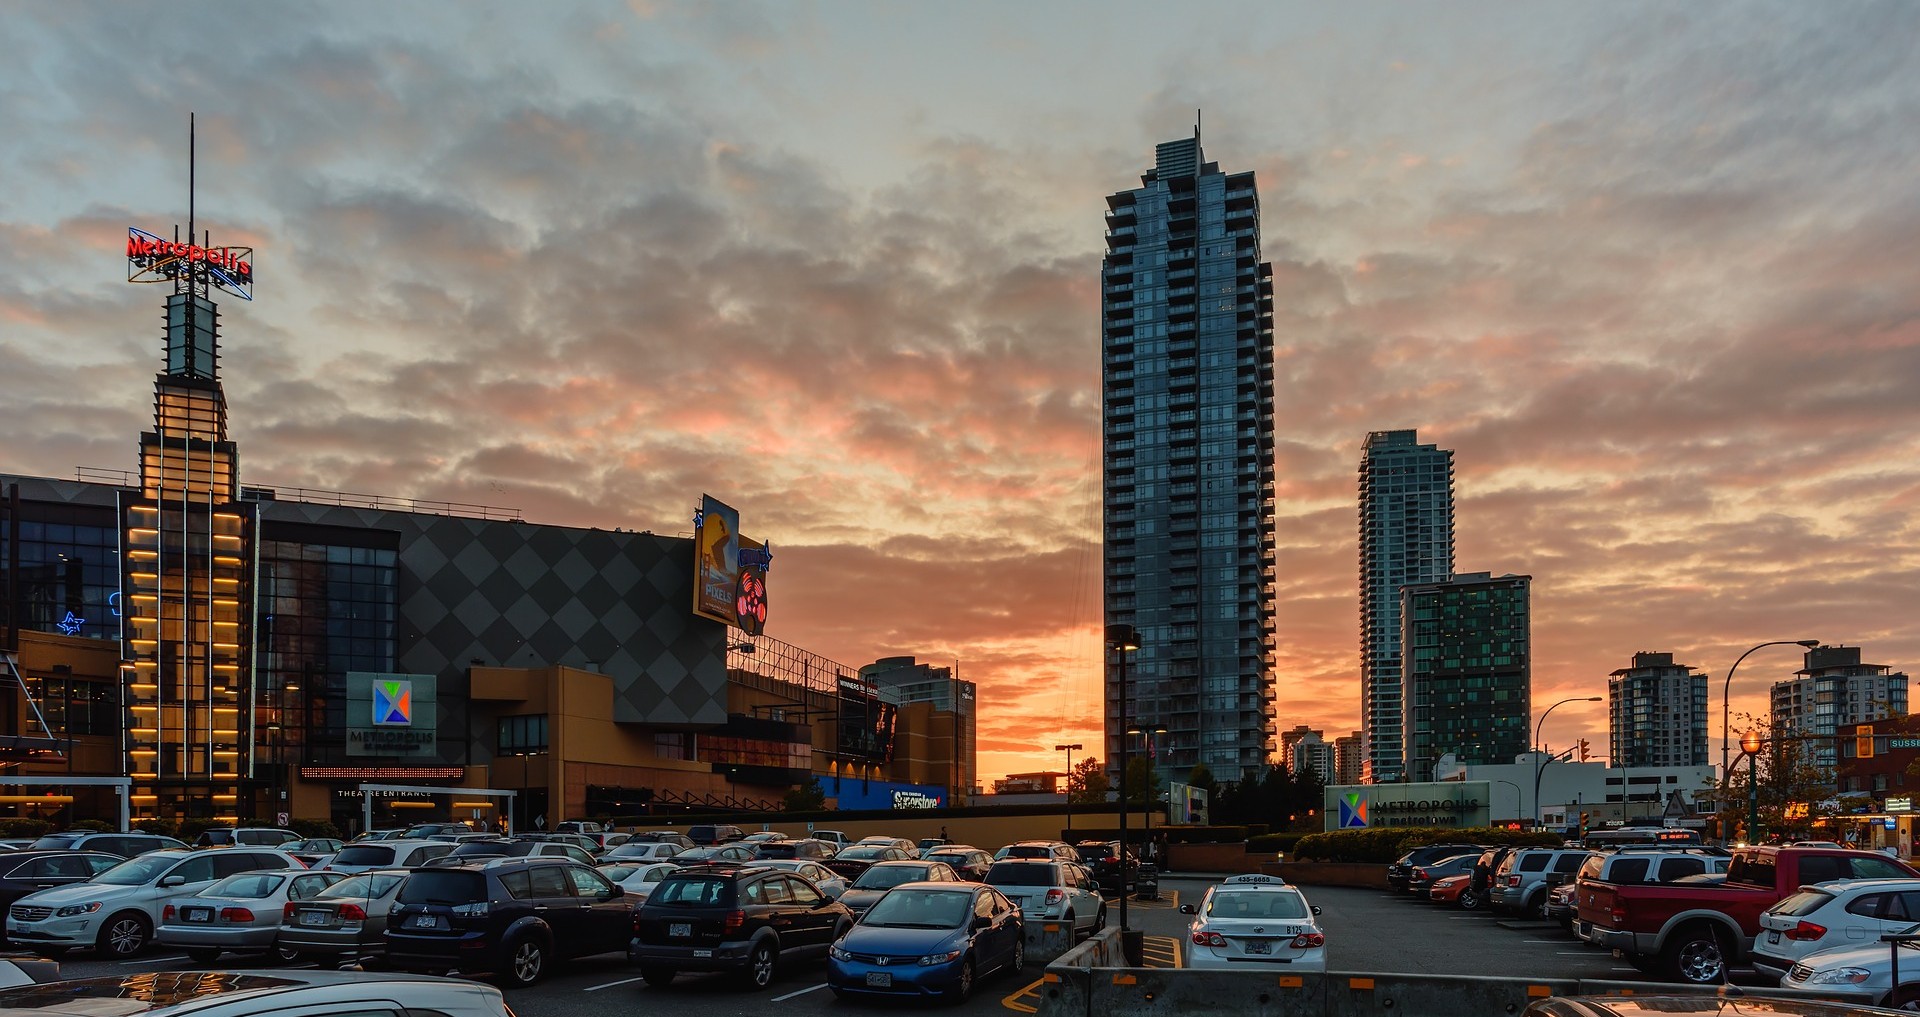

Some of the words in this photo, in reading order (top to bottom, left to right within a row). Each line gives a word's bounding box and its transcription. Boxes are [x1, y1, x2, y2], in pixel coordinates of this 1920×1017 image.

[126, 236, 251, 275] Metropolis
[705, 583, 732, 604] PIXELS
[839, 680, 860, 691] WINNERS
[350, 731, 434, 743] METROPOLIS
[1374, 799, 1479, 813] METROPOLIS
[1389, 815, 1457, 826] metrotown
[1292, 925, 1303, 935] 125
